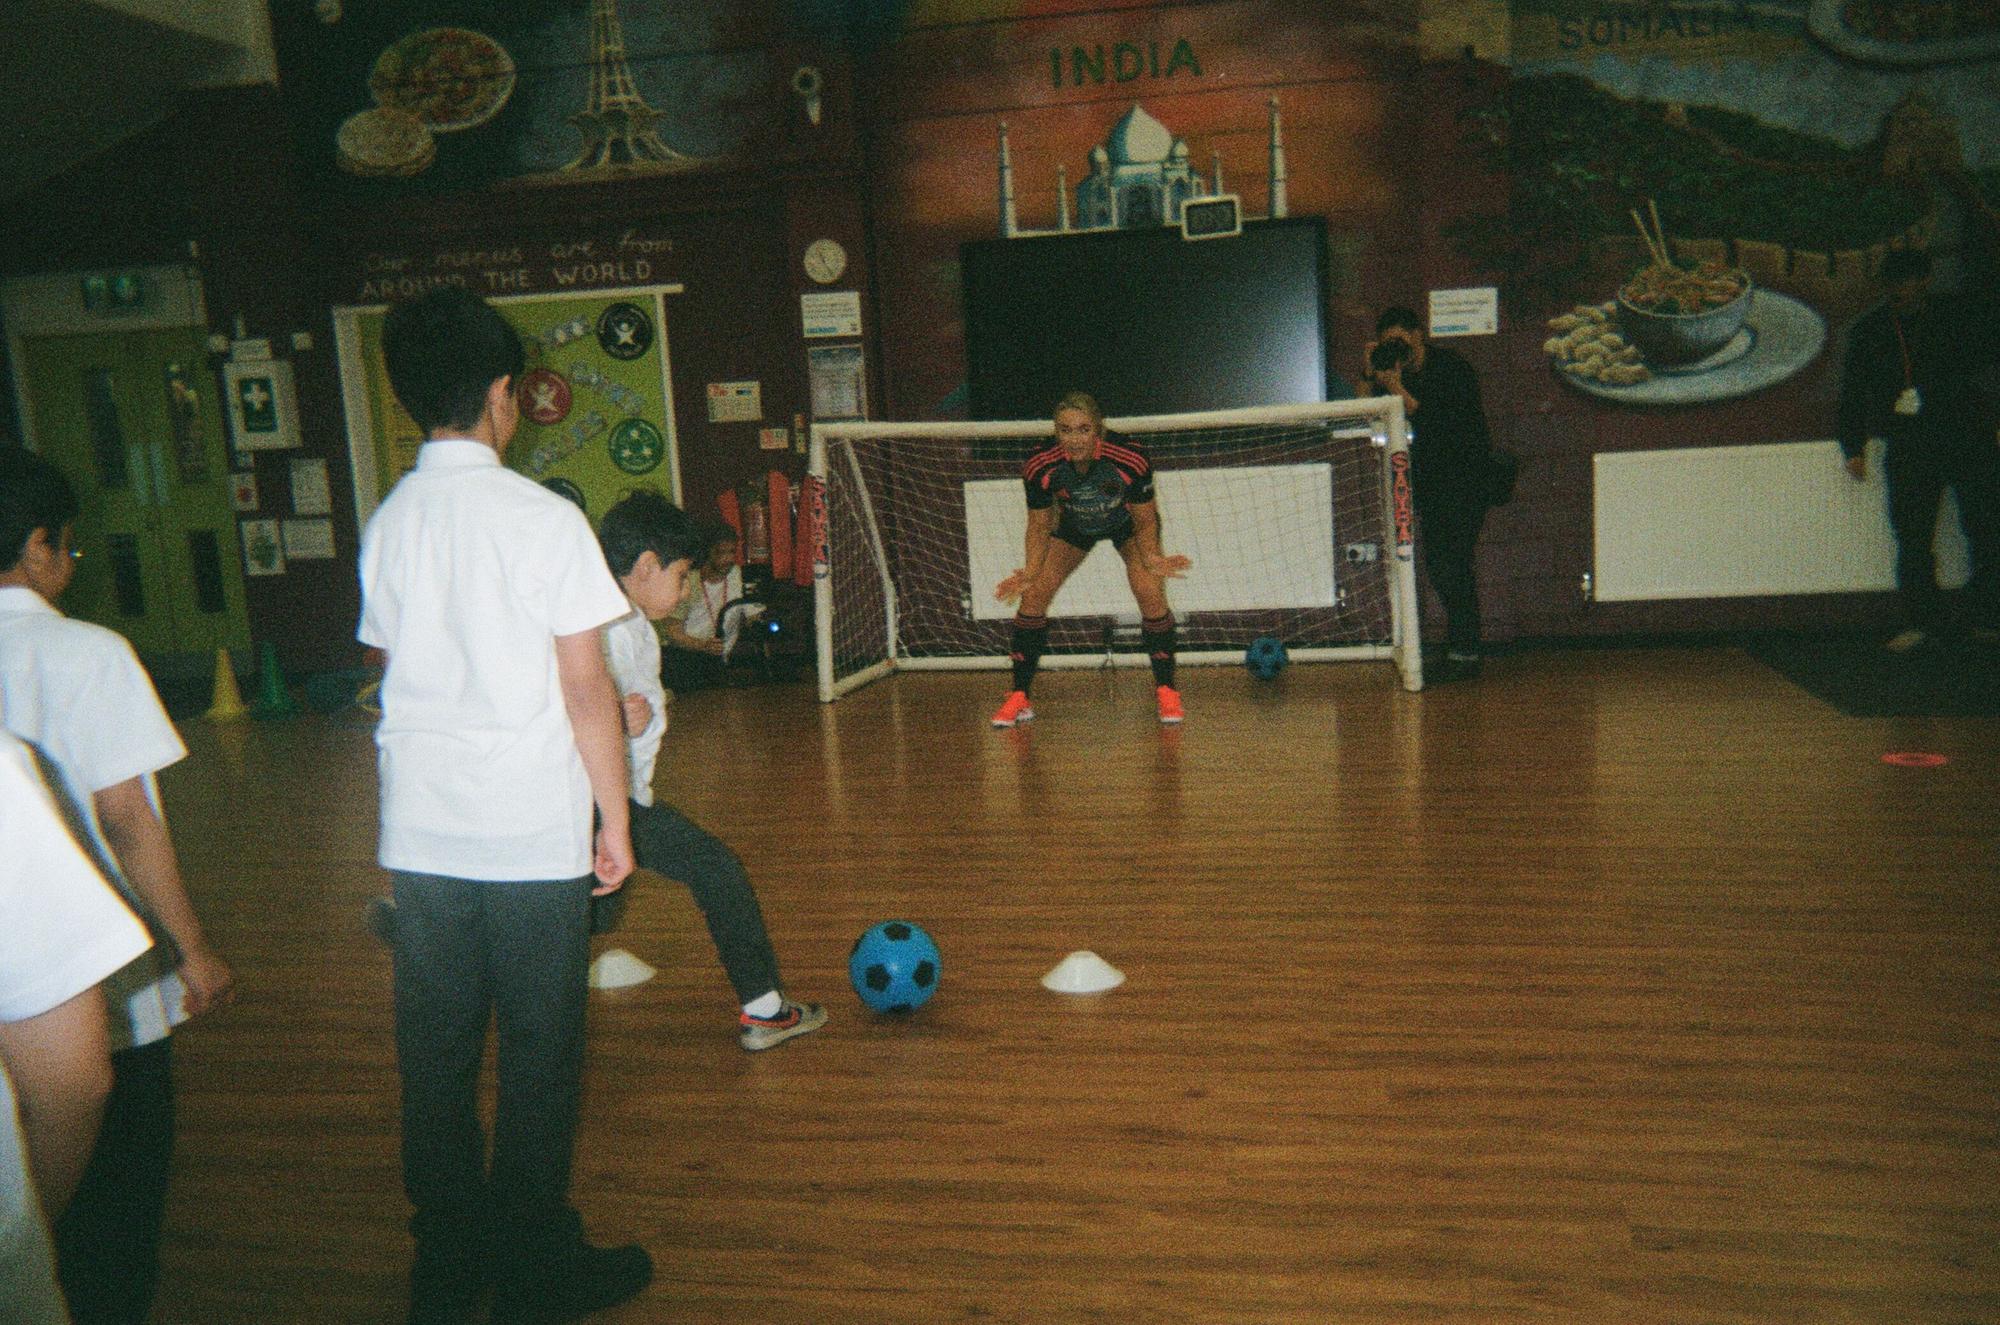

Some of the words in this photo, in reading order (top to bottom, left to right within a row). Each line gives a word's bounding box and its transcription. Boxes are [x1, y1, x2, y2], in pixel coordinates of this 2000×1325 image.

[1050, 38, 1202, 88] INDIA
[550, 242, 597, 258] are
[618, 228, 674, 252] from
[483, 268, 533, 289] THE
[552, 259, 651, 284] WORLD
